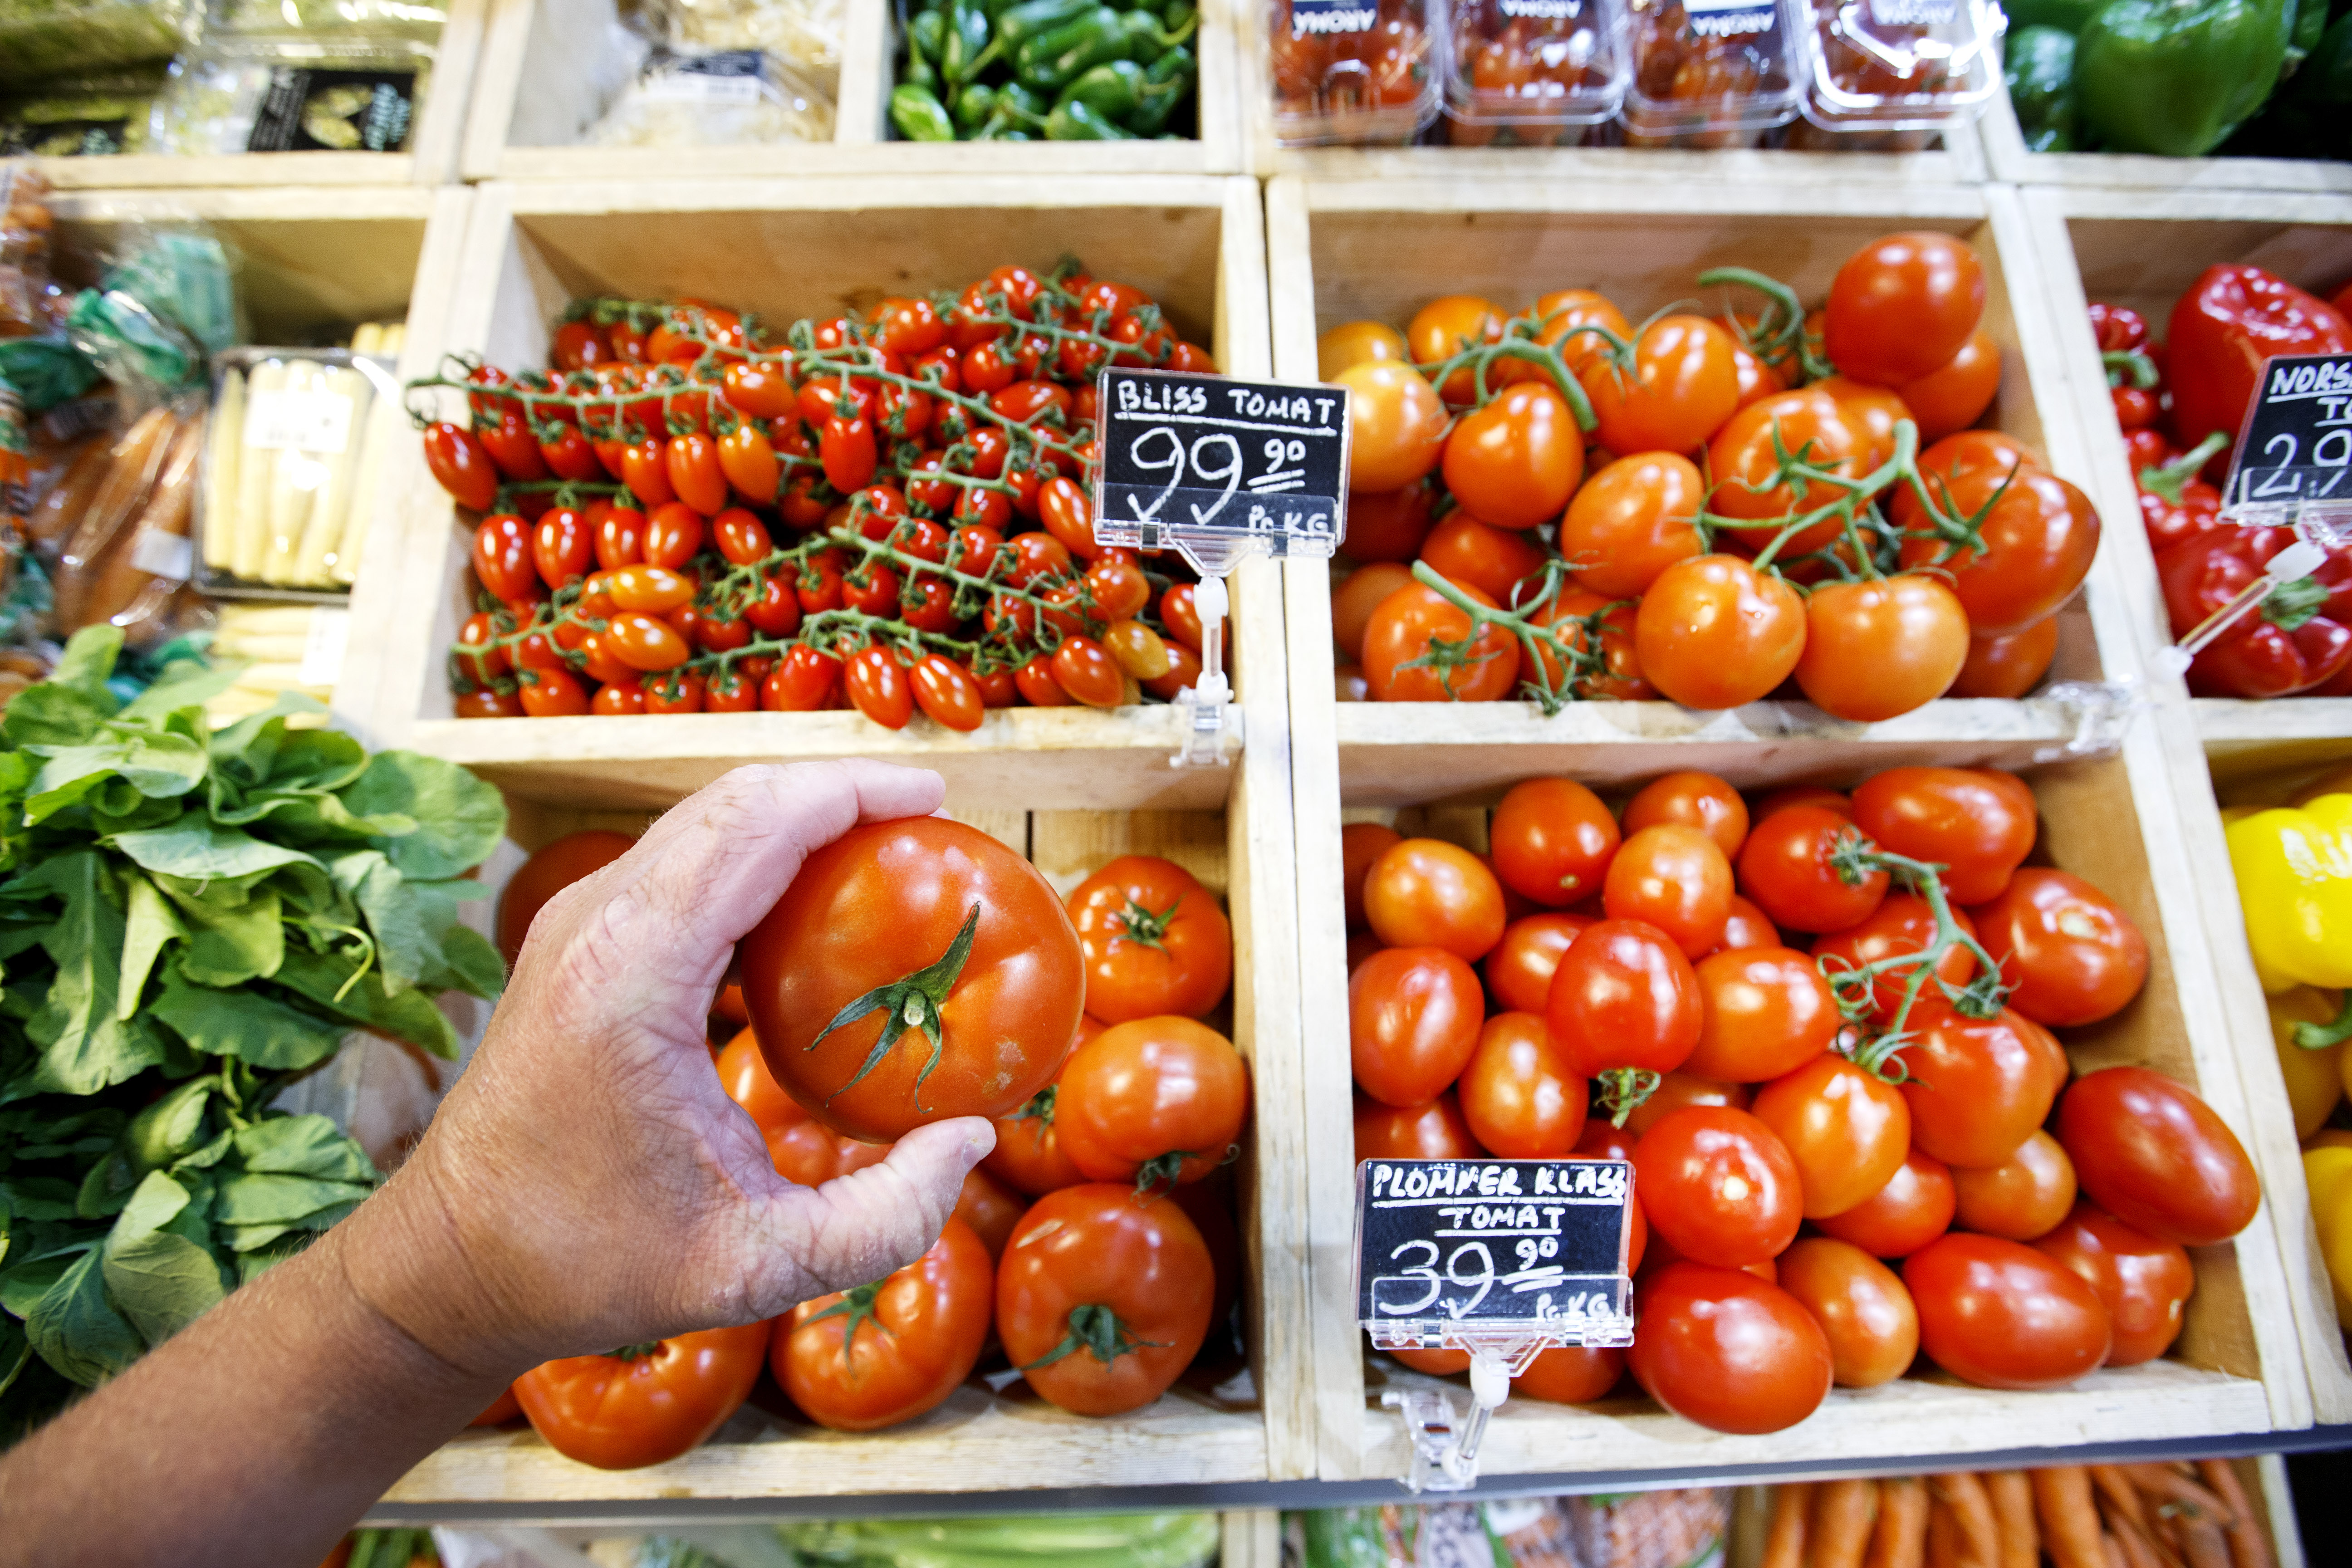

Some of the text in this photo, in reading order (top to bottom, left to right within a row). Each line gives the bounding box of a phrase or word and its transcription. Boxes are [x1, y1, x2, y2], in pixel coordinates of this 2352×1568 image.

[1293, 8, 1377, 35] AROMA
[1691, 11, 1775, 37] AROMA
[2269, 361, 2352, 395] NORS
[1118, 379, 1335, 424] BLISS TOMAT
[1127, 426, 1306, 525] 99 90
[1283, 511, 1329, 534] KG
[1534, 1165, 1627, 1199] KLASS
[1438, 1205, 1565, 1230] TOMAT
[1378, 1236, 1559, 1319] 39 90
